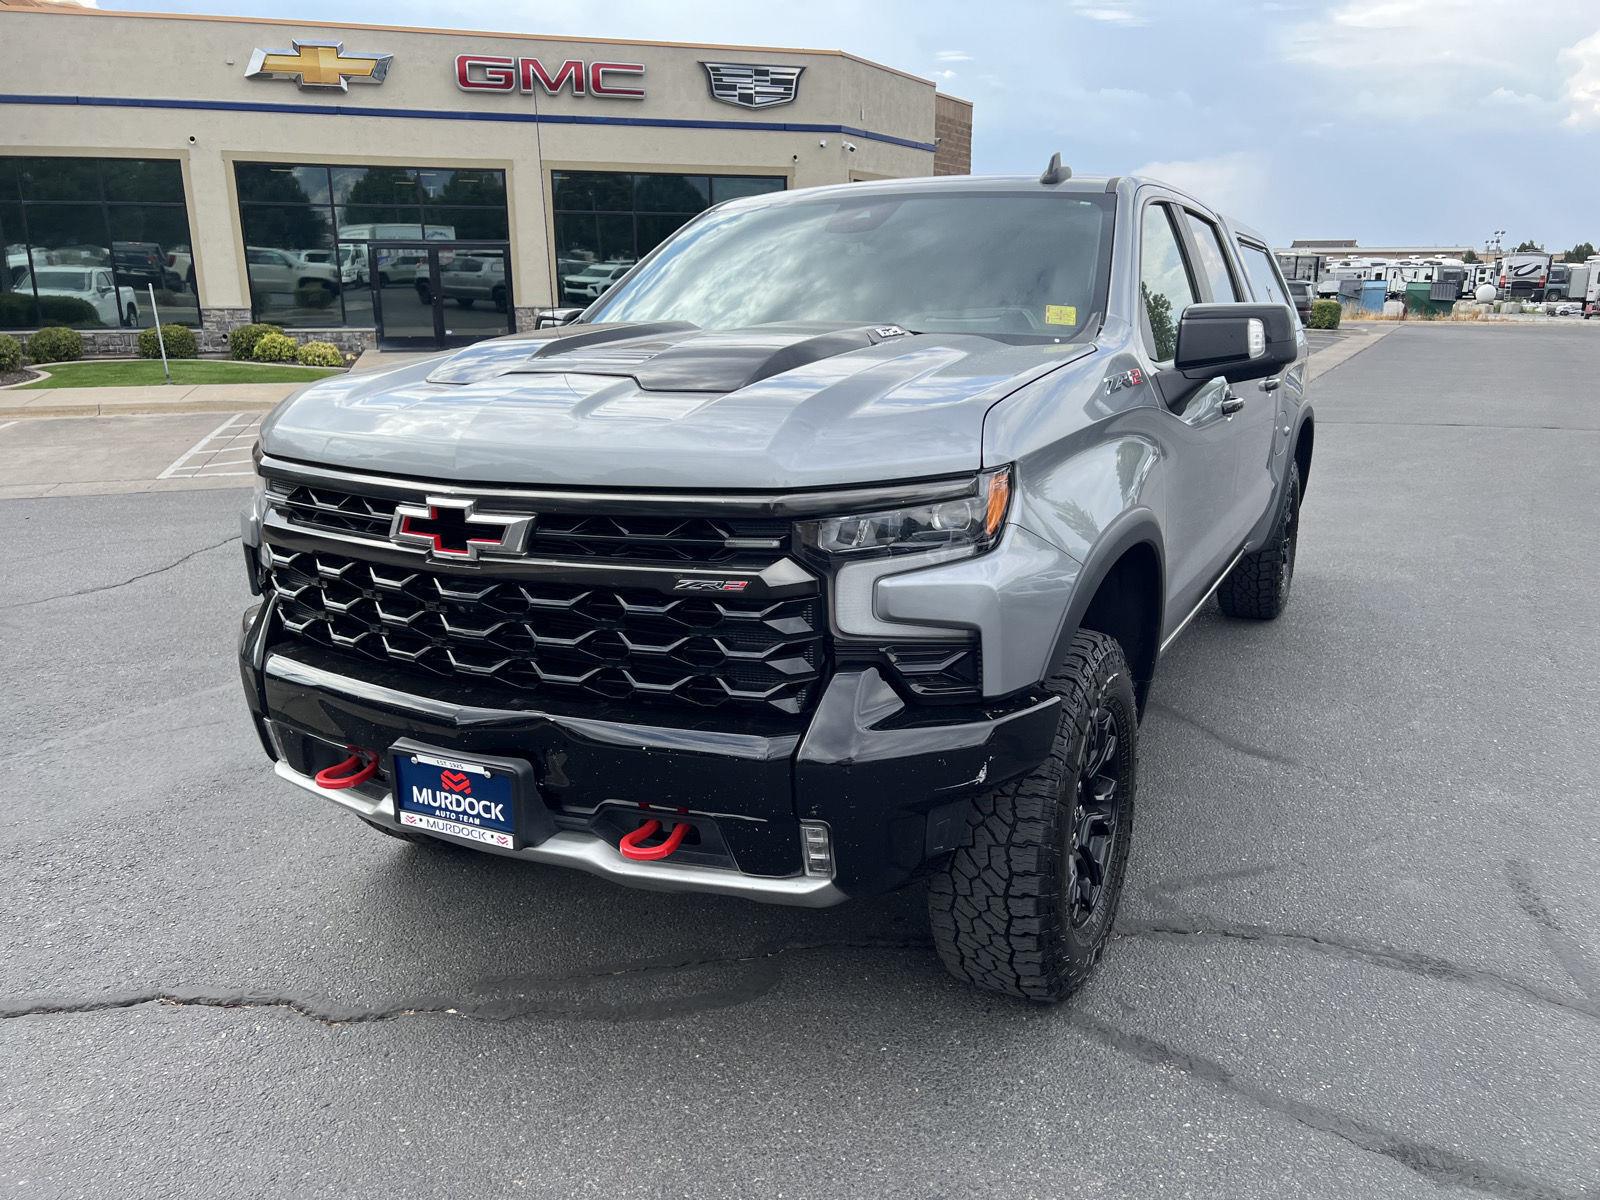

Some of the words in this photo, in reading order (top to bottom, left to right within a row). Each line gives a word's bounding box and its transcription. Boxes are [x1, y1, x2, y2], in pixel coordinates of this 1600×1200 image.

[455, 54, 646, 100] GMC
[673, 579, 749, 591] ZR2
[412, 785, 505, 822] MURDOCK
[435, 809, 456, 820] AUTO
[458, 814, 480, 825] TEAM
[426, 818, 487, 841] MURDOCK
